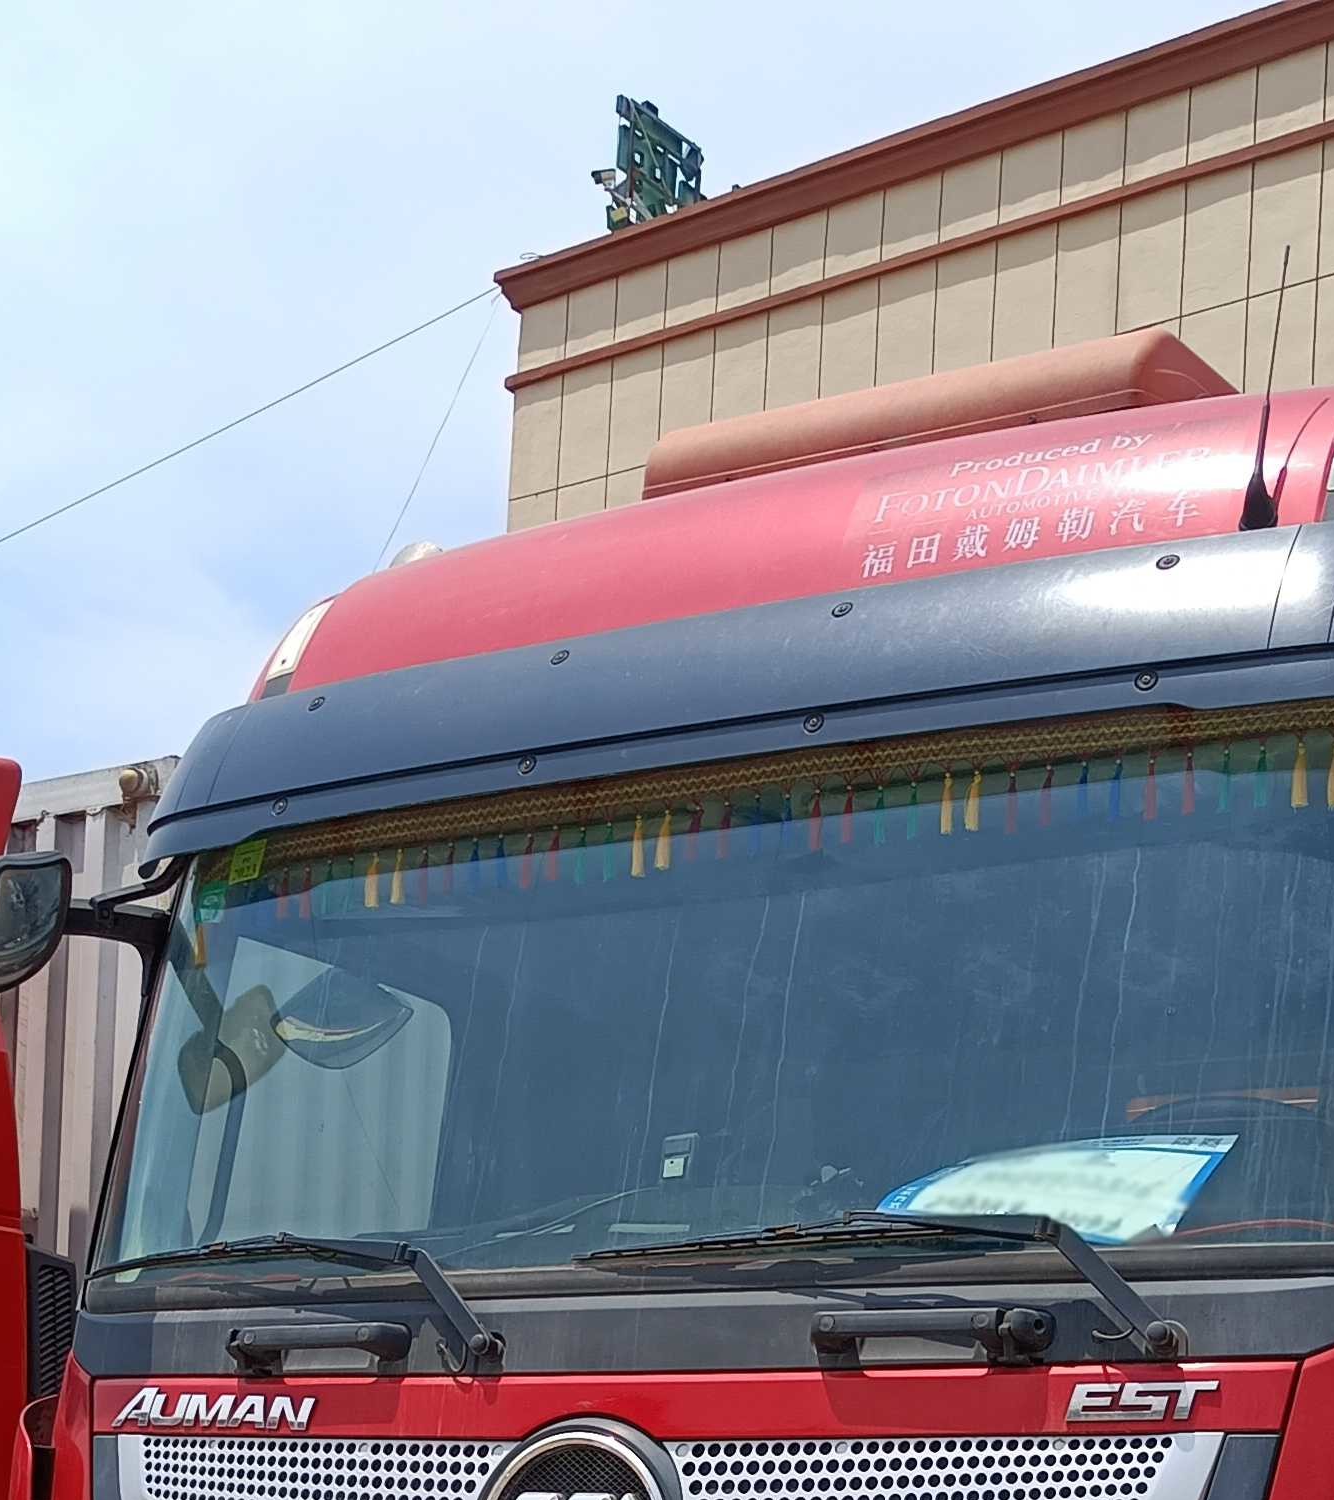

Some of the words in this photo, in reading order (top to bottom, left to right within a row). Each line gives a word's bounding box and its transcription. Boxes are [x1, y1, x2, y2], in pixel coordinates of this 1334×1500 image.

[949, 437, 1103, 478] Produced
[1111, 432, 1154, 452] by
[861, 492, 1203, 578] 福田戴姆勒汽车
[111, 1386, 317, 1432] AUMAN
[1065, 1380, 1220, 1422] EST
